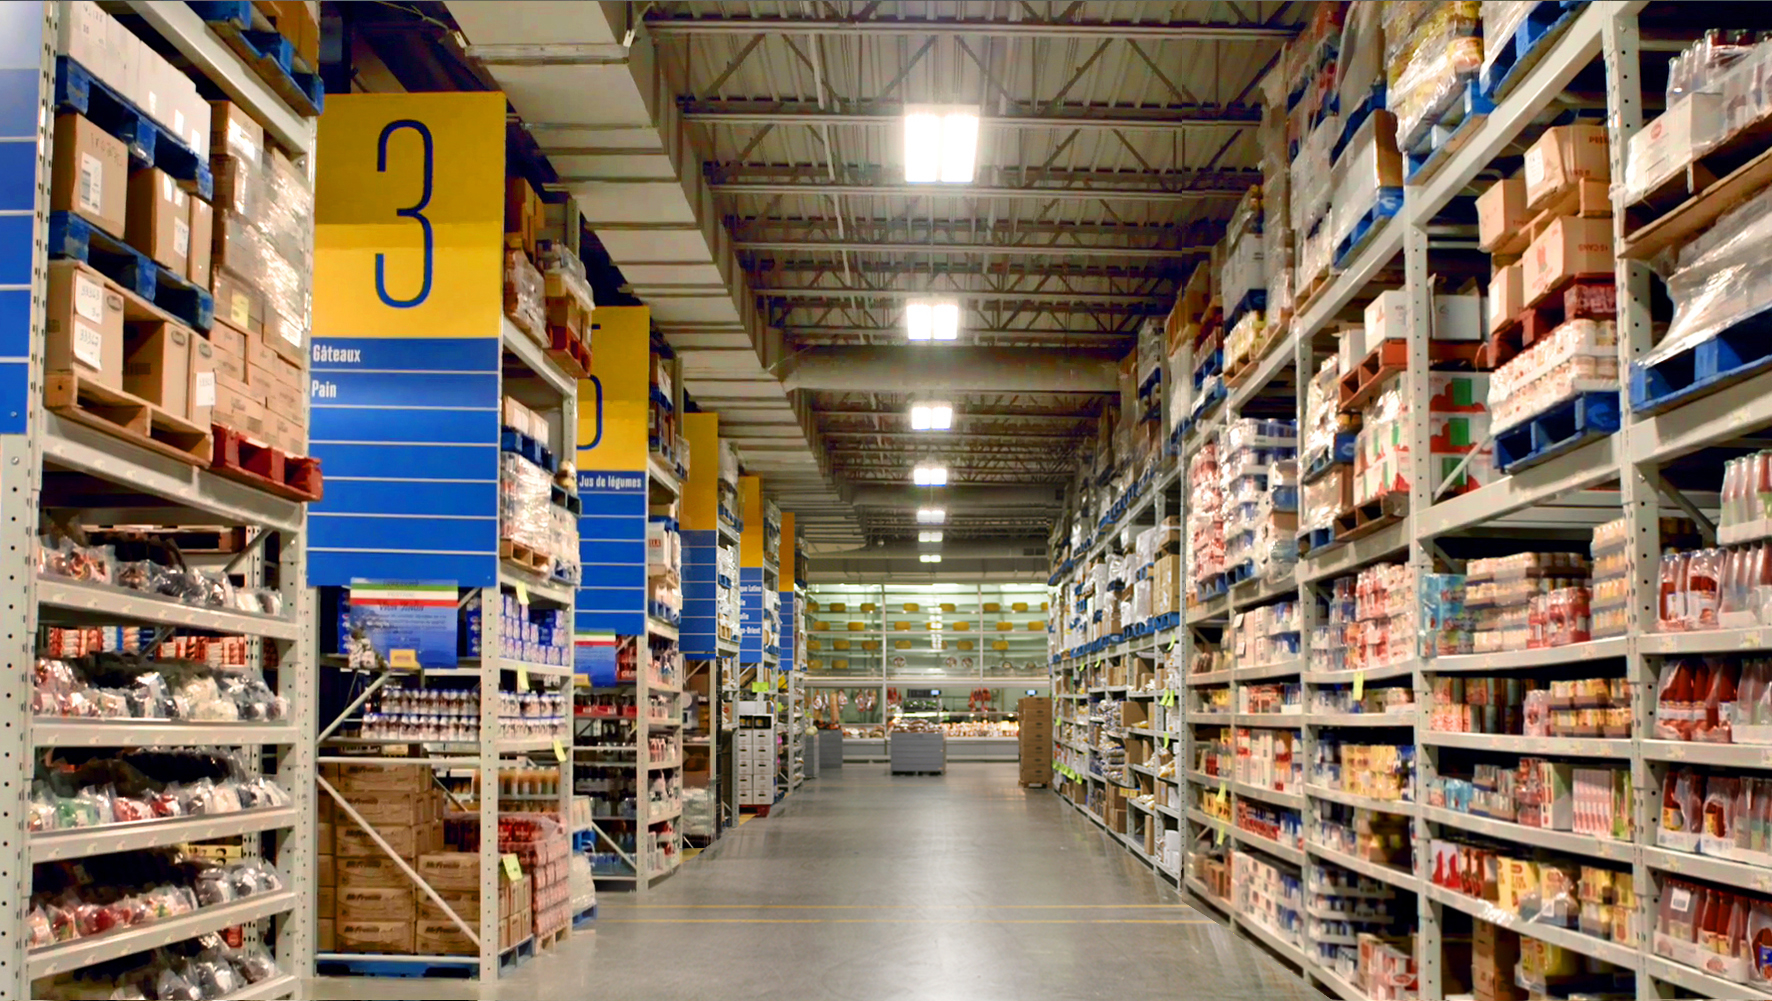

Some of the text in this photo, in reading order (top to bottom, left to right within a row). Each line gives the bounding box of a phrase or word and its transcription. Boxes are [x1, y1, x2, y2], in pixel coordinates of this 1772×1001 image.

[375, 118, 434, 309] 3
[312, 344, 361, 363] Gâteaux
[311, 380, 337, 399] Pain
[579, 475, 642, 490] Jus de légumes
